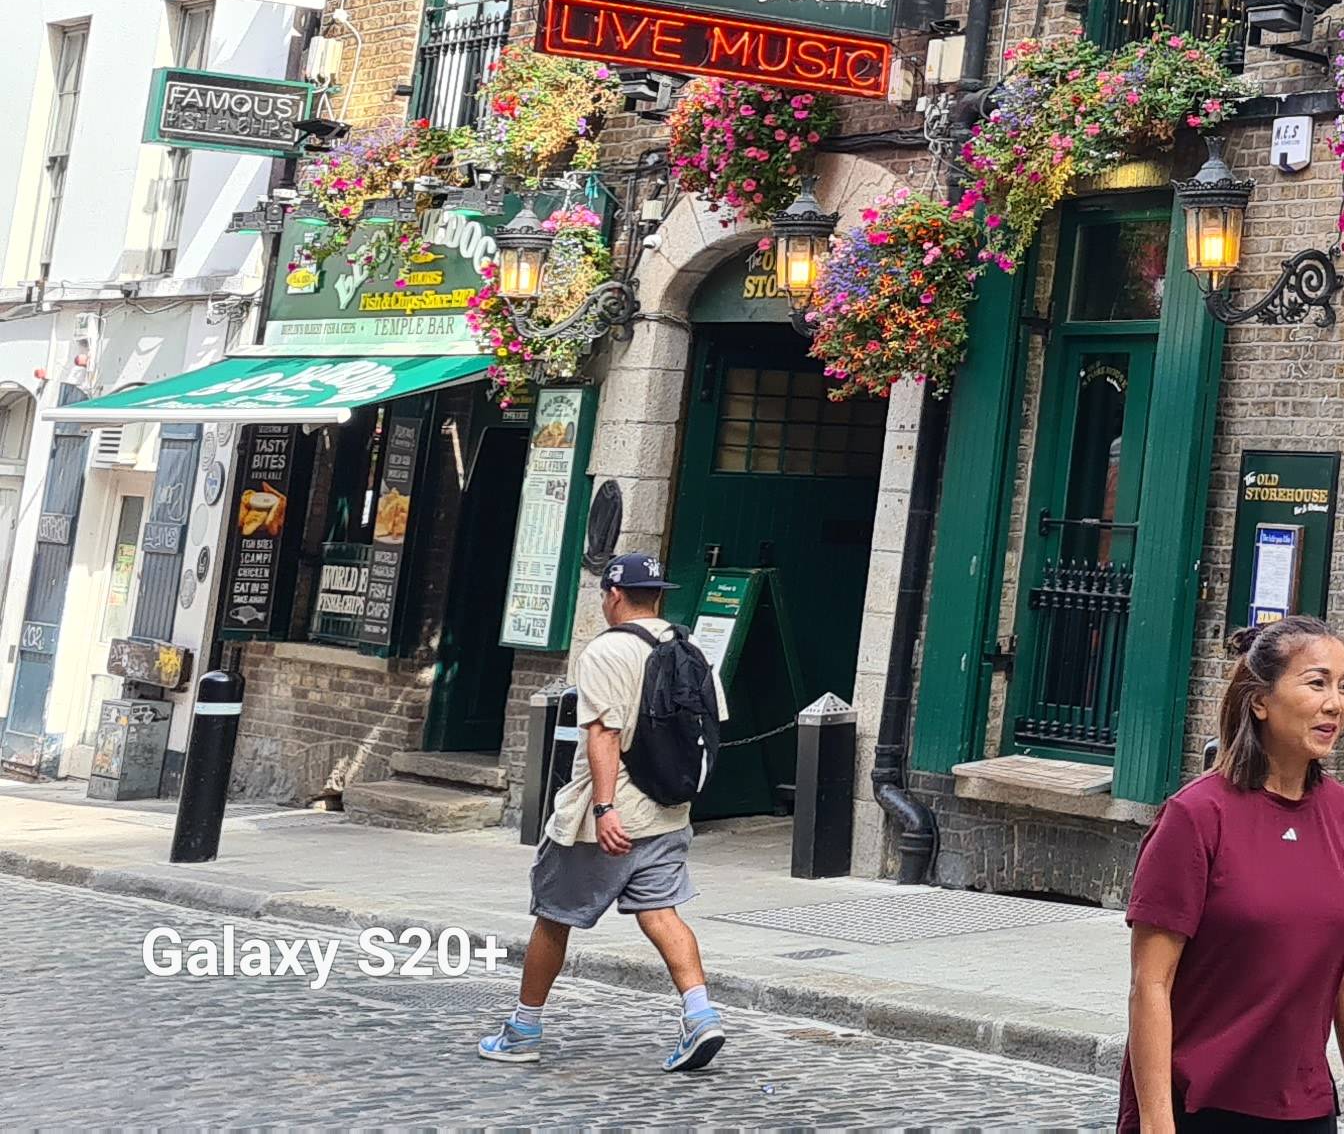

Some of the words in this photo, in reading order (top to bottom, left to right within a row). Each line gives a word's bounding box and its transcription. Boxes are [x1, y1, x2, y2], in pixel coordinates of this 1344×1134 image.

[560, 4, 685, 60] LIVE
[710, 26, 878, 88] MUSIC
[169, 85, 294, 118] FAMOUS
[374, 317, 422, 336] TEMPLE
[427, 316, 455, 334] BAR
[255, 439, 288, 453] TASTY
[252, 454, 287, 469] BITES
[1256, 473, 1280, 486] OLD
[1244, 487, 1329, 503] STOREHOUSE
[233, 582, 250, 594] EAT
[250, 583, 259, 594] IN
